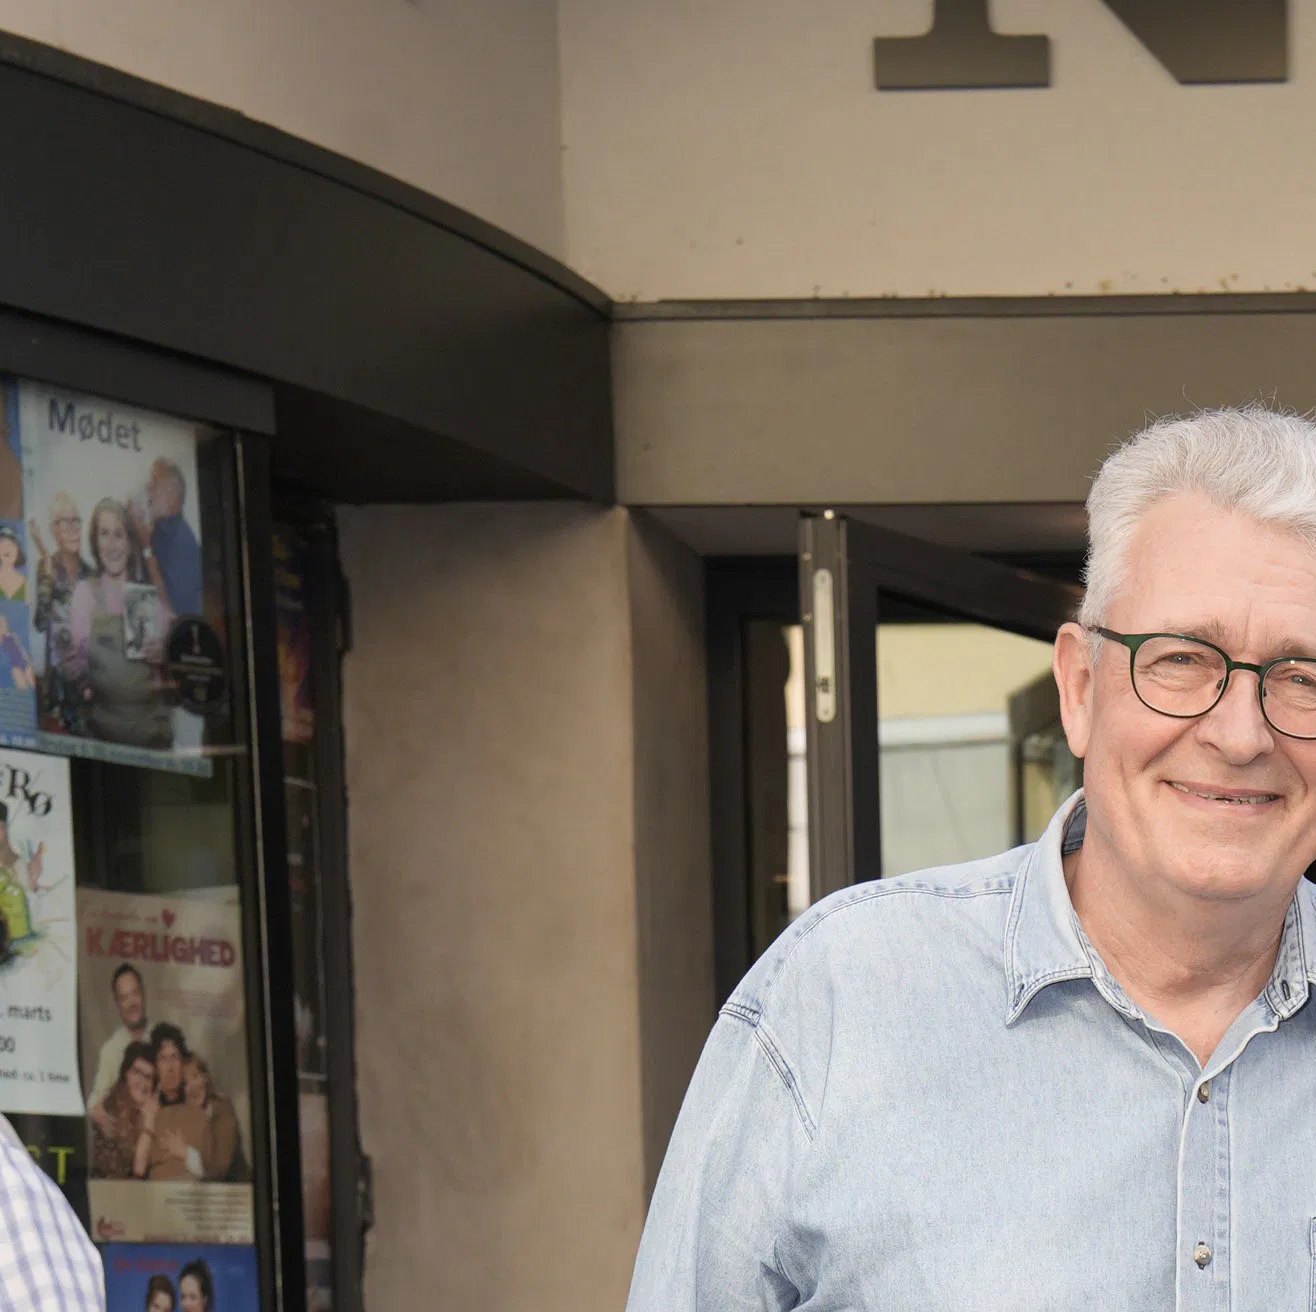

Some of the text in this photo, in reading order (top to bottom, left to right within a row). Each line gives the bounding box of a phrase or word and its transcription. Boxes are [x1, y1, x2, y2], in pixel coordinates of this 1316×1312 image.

[49, 398, 142, 452] Mødet
[86, 927, 235, 967] KÆRLIGHED
[8, 1005, 51, 1022] marts
